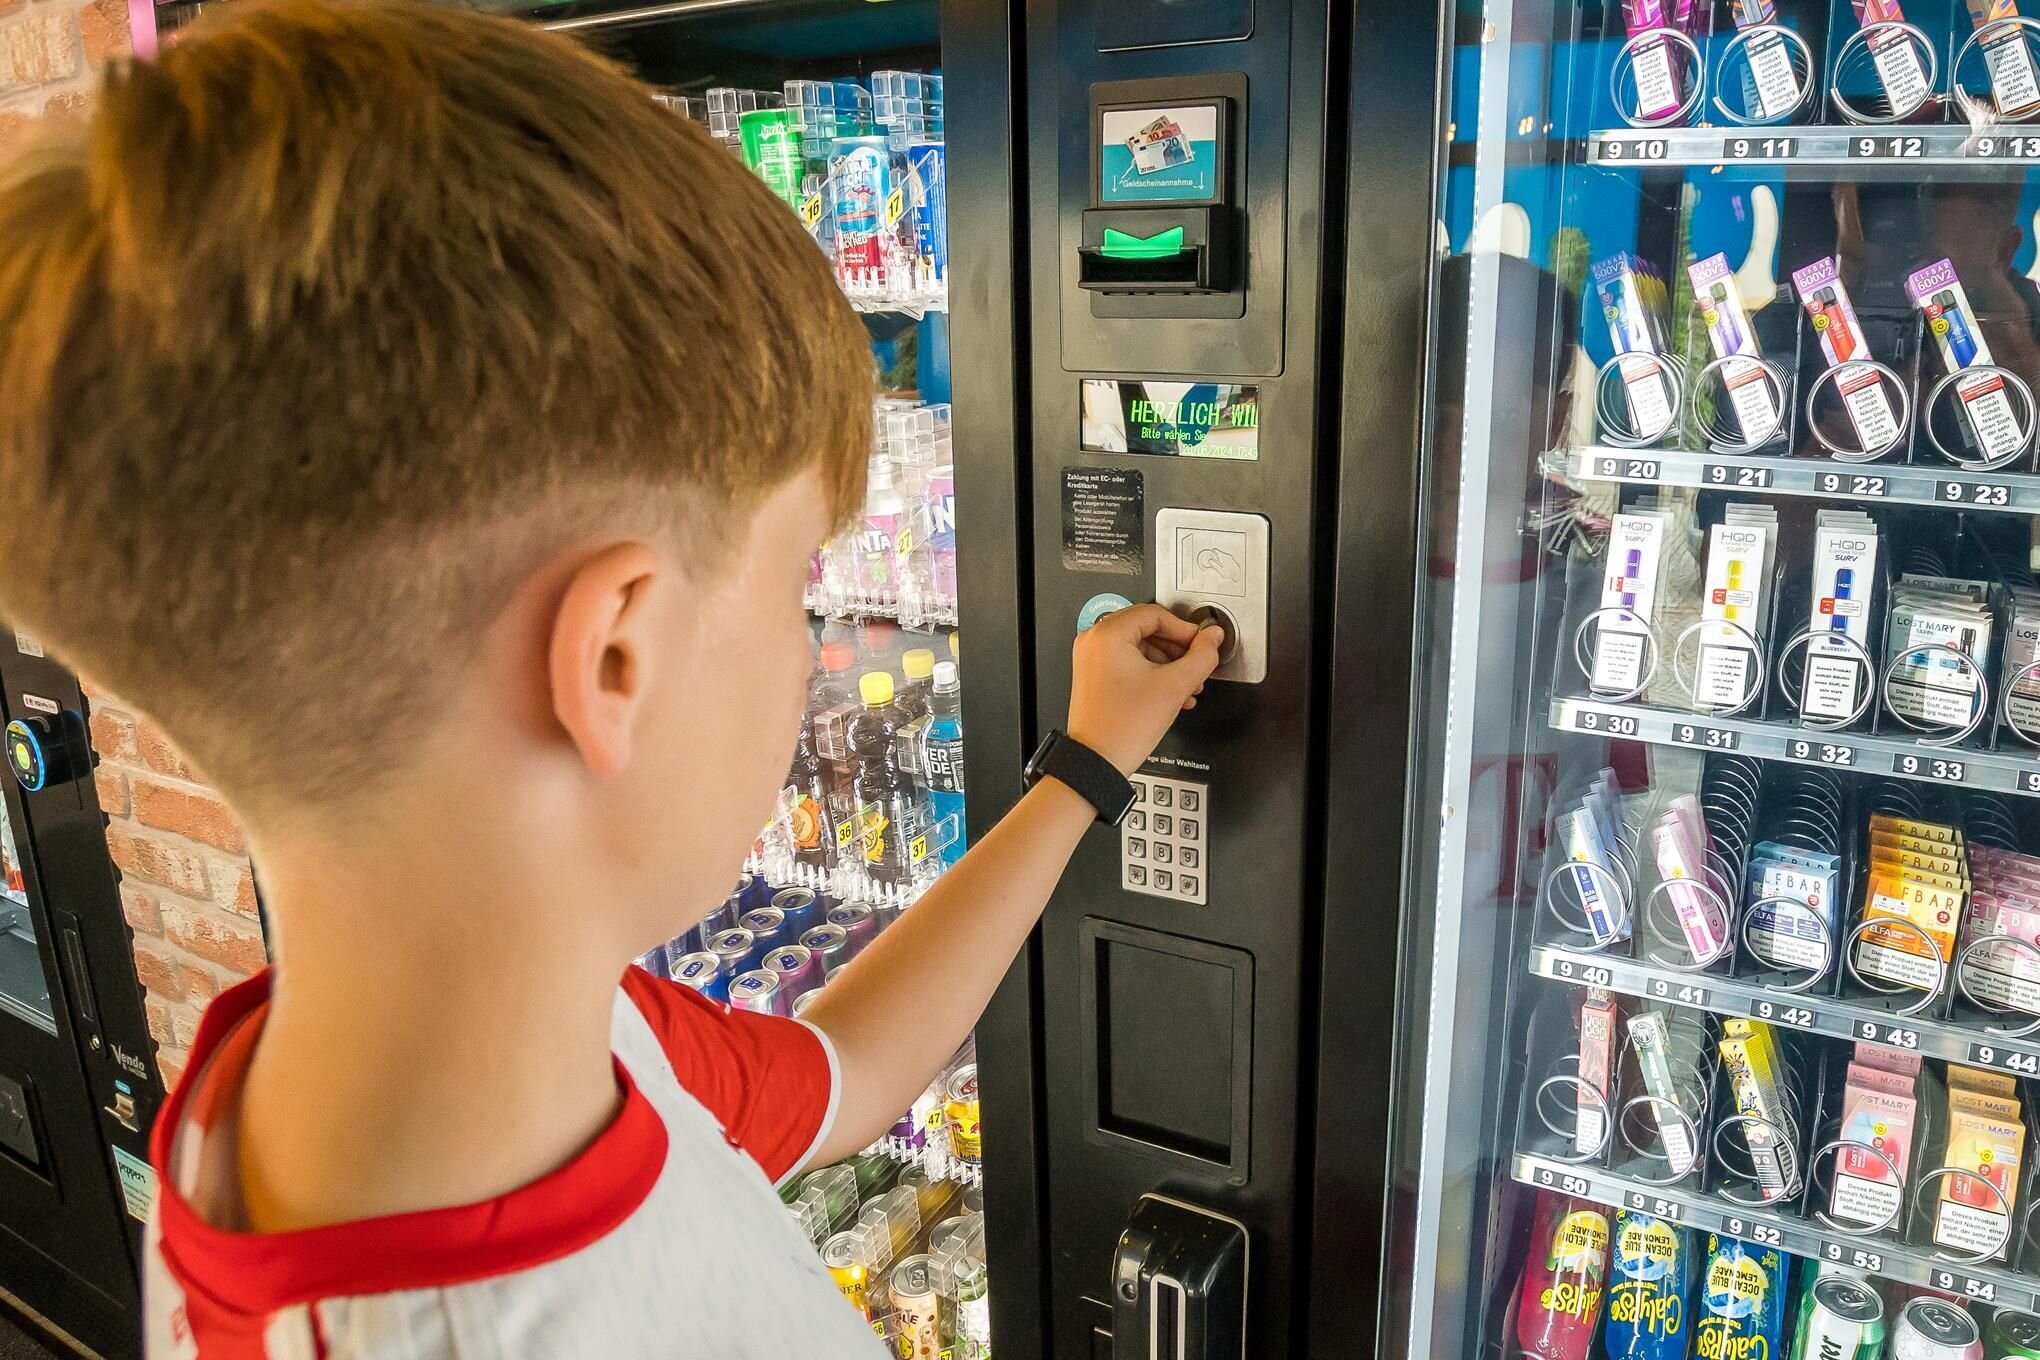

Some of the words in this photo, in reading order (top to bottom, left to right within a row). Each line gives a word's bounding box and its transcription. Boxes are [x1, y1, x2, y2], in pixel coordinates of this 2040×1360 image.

[1148, 133, 1159, 141] 10
[1166, 138, 1179, 147] 20
[1608, 142, 1622, 159] 9
[1635, 140, 1664, 158] 10
[1734, 140, 1749, 157] 9
[1762, 139, 1791, 157] 11
[1860, 139, 1875, 156] 9
[1890, 138, 1922, 156] 12
[1977, 139, 1994, 156] 9
[2010, 139, 2040, 156] 13
[1123, 179, 1193, 187] Geldscheinannahme
[808, 200, 819, 219] 16
[888, 197, 900, 217] 17
[1595, 260, 1625, 279] 600V2
[1693, 263, 1725, 283] 600V2
[1797, 259, 1831, 280] ELFBAR
[1800, 268, 1833, 288] 600V2
[1915, 262, 1949, 282] ELFBAR
[1918, 269, 1953, 292] 600V2
[1929, 305, 1938, 313] 20
[1131, 400, 1220, 425] HERZLICH
[1141, 427, 1161, 439] Bitte
[1165, 428, 1191, 440] wählen
[1067, 474, 1089, 482] Zahlung
[1603, 460, 1616, 475] 9
[1628, 461, 1656, 478] 20
[1712, 467, 1726, 482] 9
[1738, 470, 1767, 486] 21
[1824, 475, 1839, 492] 9
[1852, 477, 1884, 496] 22
[1946, 483, 1962, 500] 9
[1974, 486, 2008, 505] 23
[1620, 521, 1653, 533] HQD
[898, 532, 911, 553] 27
[1721, 531, 1756, 543] HQD
[1830, 539, 1866, 551] HQD
[1834, 554, 1858, 562] SURV
[1907, 579, 1934, 589] LOST
[1935, 581, 1962, 590] MARY
[1897, 617, 1924, 628] LOST
[1926, 622, 1956, 633] MARY
[1584, 713, 1597, 728] 9
[1608, 717, 1635, 733] 30
[1681, 726, 1694, 742] 9
[1706, 730, 1733, 748] 31
[1794, 741, 1810, 759] 9
[1821, 745, 1852, 765] 32
[1177, 759, 1210, 771] Wahltaste
[1902, 756, 1918, 773] 9
[1932, 760, 1963, 780] 33
[1158, 792, 1165, 802] 2
[1185, 796, 1191, 806] 3
[840, 827, 851, 840] 36
[1132, 816, 1138, 825] 4
[1159, 820, 1164, 830] 5
[1184, 825, 1191, 835] 6
[913, 842, 924, 856] 37
[1132, 843, 1139, 852] 7
[1158, 848, 1165, 858] 8
[1185, 853, 1191, 863] 9
[1159, 875, 1165, 885] 0
[1754, 911, 1771, 921] ELFA
[1869, 925, 1891, 936] ELFA
[1560, 962, 1572, 976] 9
[1583, 968, 1609, 984] 40
[1655, 981, 1668, 996] 9
[1678, 987, 1704, 1004] 41
[1759, 1002, 1772, 1018] 9
[1783, 1008, 1812, 1027] 42
[1862, 1023, 1877, 1039] 9
[1887, 1029, 1917, 1049] 43
[111, 1044, 145, 1071] Vendo
[1862, 1047, 1887, 1058] LOST
[1889, 1051, 1915, 1065] MARY
[1979, 1046, 1994, 1064] 9
[2005, 1052, 2038, 1074] 44
[1880, 1077, 1907, 1088] MARY
[1881, 1100, 1910, 1111] MARY
[1956, 1095, 1983, 1106] LOST
[1984, 1102, 2012, 1113] MARY
[928, 1113, 940, 1124] 47
[1959, 1119, 1986, 1130] LOST
[1988, 1126, 2016, 1137] MARY
[1541, 1171, 1553, 1185] 9
[1562, 1177, 1587, 1194] 50
[1631, 1195, 1645, 1209] 9
[1654, 1200, 1679, 1217] 51
[1627, 1231, 1670, 1245] LEMONADE
[1729, 1219, 1743, 1234] 9
[1753, 1226, 1781, 1246] 52
[1624, 1240, 1642, 1253] BLUE
[1644, 1243, 1672, 1257] OCEAN
[1828, 1244, 1842, 1260] 9
[1853, 1250, 1882, 1272] 53
[1711, 1275, 1730, 1289] BLUE
[1714, 1266, 1759, 1283] LEMONADE
[1732, 1278, 1760, 1296] OCEAN
[1939, 1273, 1953, 1289] 9
[1965, 1280, 1995, 1300] 54
[1611, 1290, 1682, 1335] Calypso
